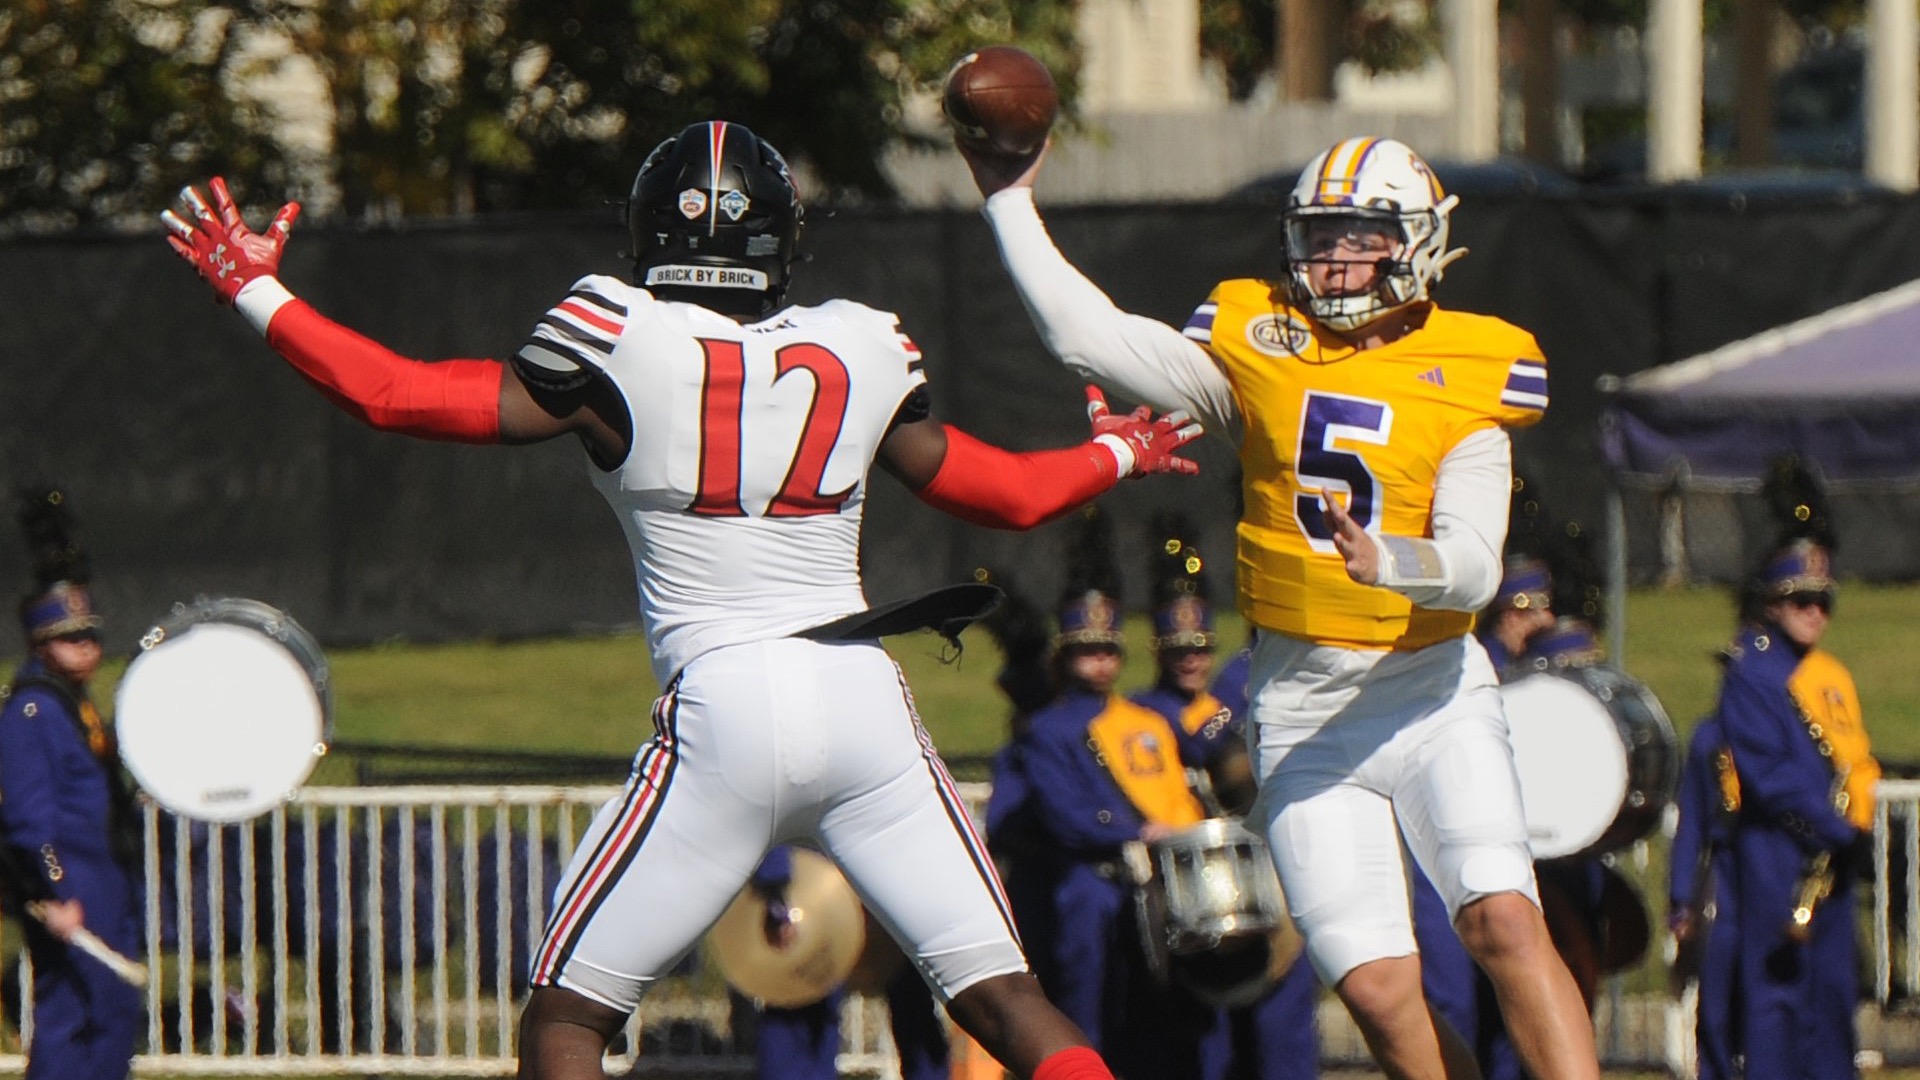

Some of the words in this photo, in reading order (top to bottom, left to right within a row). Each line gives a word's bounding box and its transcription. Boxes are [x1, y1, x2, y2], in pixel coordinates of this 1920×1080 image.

[657, 268, 692, 282] BRICK
[696, 269, 714, 283] BY
[719, 270, 755, 285] BRICK
[684, 336, 860, 518] 12
[1294, 388, 1394, 554] 5
